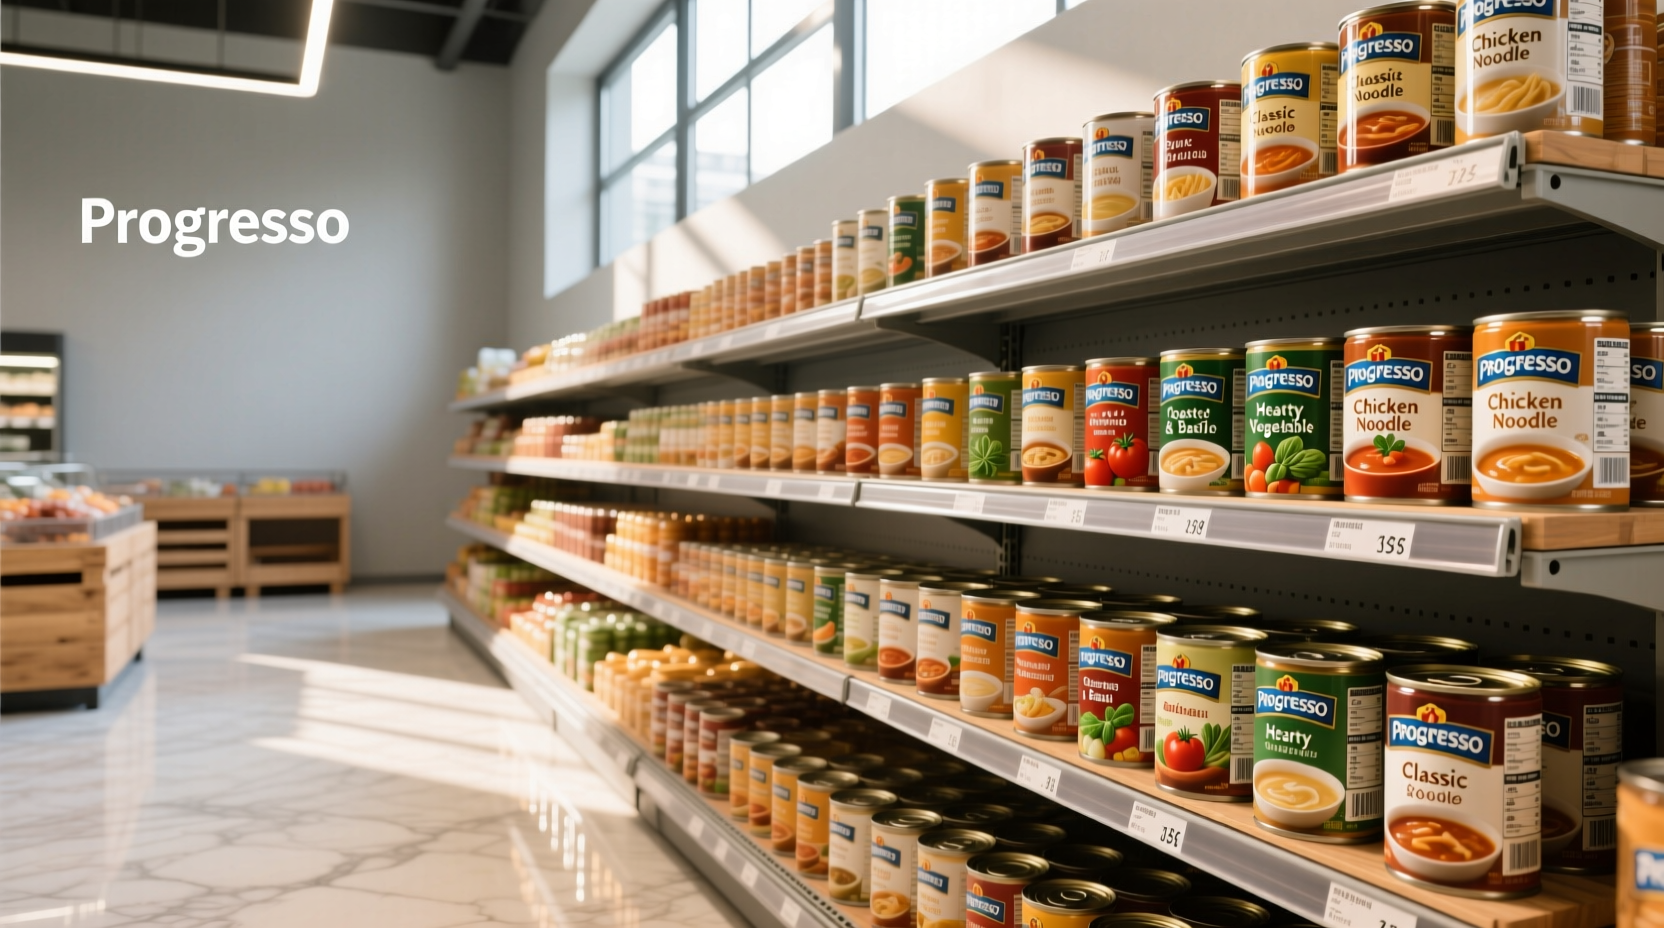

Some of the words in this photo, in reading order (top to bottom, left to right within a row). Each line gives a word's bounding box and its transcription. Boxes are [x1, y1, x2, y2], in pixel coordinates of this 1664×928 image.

[1472, 28, 1542, 52] Chicken
[1473, 46, 1530, 68] Noodle
[1256, 401, 1304, 421] Hearty
[1353, 397, 1419, 415] Chicken
[1487, 391, 1563, 411] Chicken
[1356, 415, 1412, 432] Noodle
[1492, 411, 1559, 430] Noodle
[1265, 722, 1312, 750] Hearty
[1402, 761, 1469, 789] Classic
